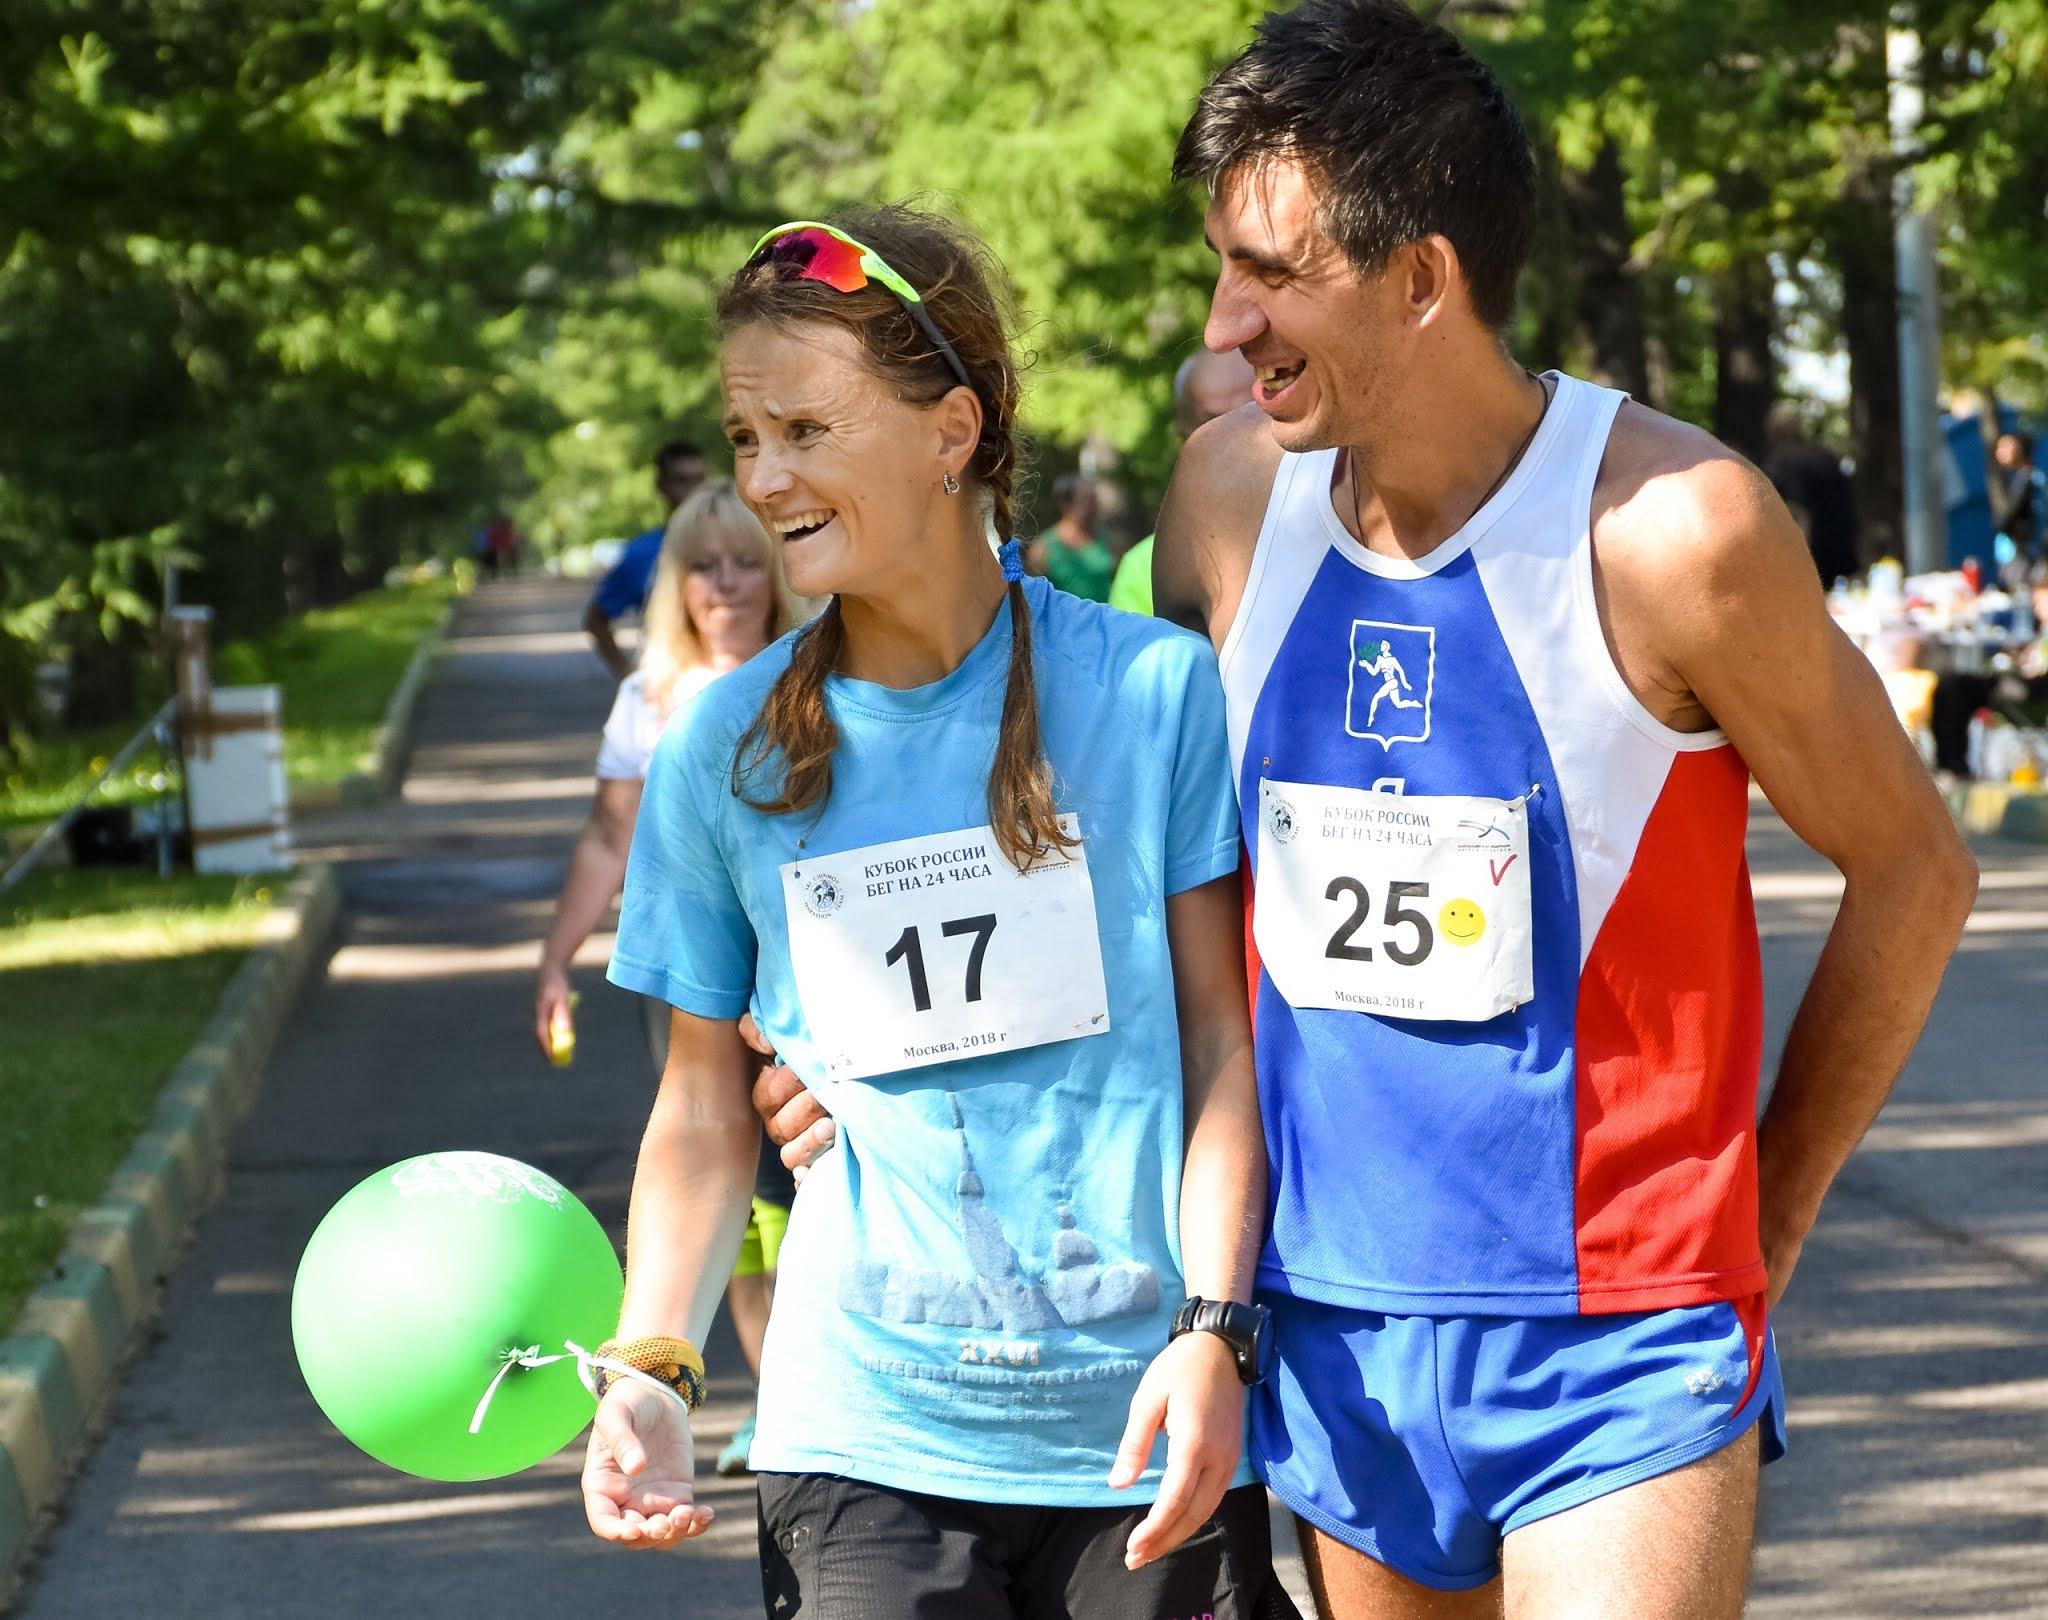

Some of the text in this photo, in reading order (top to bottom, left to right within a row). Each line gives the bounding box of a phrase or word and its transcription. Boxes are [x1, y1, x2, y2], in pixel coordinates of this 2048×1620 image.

[1324, 805, 1430, 827] КУБОК РОССИИ
[1322, 824, 1433, 846] БЕГ НА 24 ЧАСА
[864, 845, 987, 878] КУБОК РОССИИ
[866, 864, 992, 897] БЕГ НА 24 ЧАСА
[1325, 876, 1434, 966] 25
[885, 913, 997, 1012] 17
[1334, 990, 1425, 1009] Москва, 2018 г
[904, 1032, 1007, 1059] Москва, 2018 г
[957, 1338, 1039, 1366] XXVI
